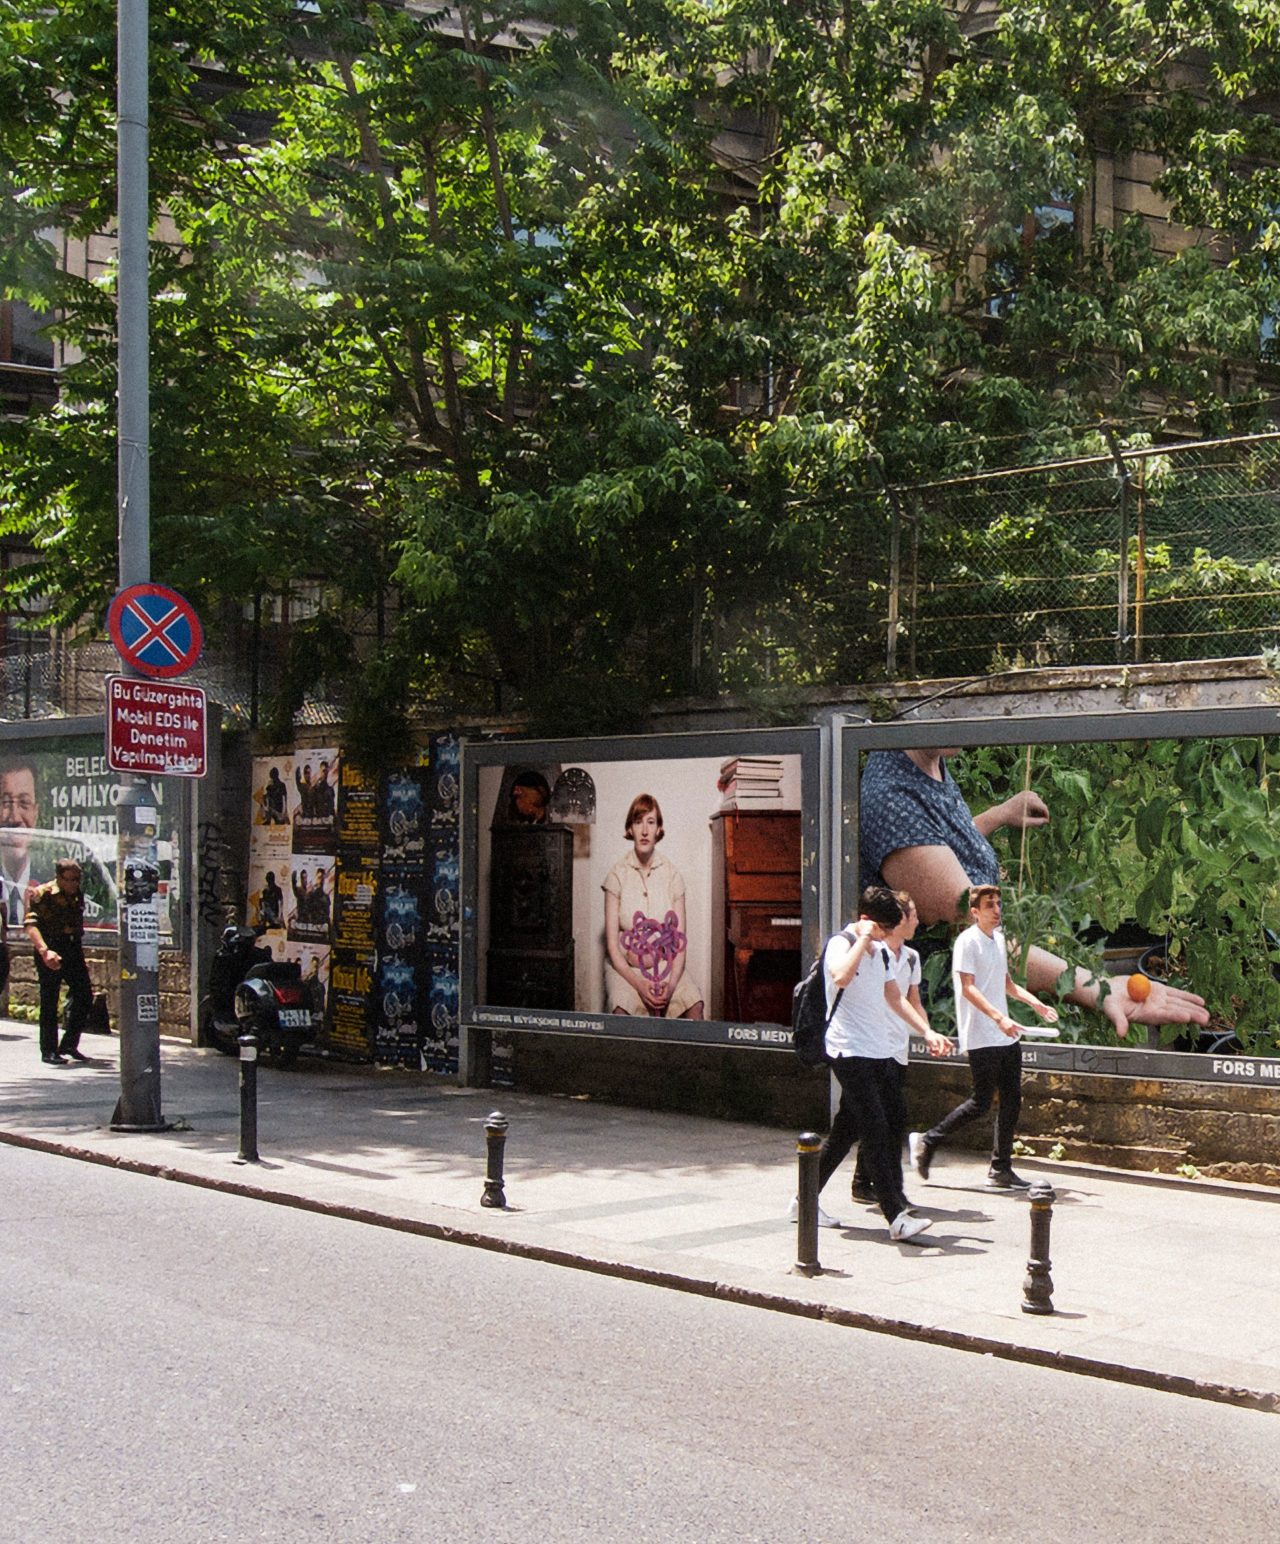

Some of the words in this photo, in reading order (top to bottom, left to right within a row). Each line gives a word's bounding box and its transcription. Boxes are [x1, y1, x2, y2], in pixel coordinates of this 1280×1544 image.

[113, 682, 131, 700] Bu
[133, 685, 203, 709] Güzergahta
[117, 707, 153, 726] Mobil
[155, 711, 182, 729] EDS
[183, 715, 200, 731] ile
[130, 728, 188, 749] Denetim
[51, 786, 69, 808] 16
[728, 1027, 759, 1041] FORS
[761, 1030, 795, 1044] MEDY
[1213, 1060, 1256, 1077] FORS
